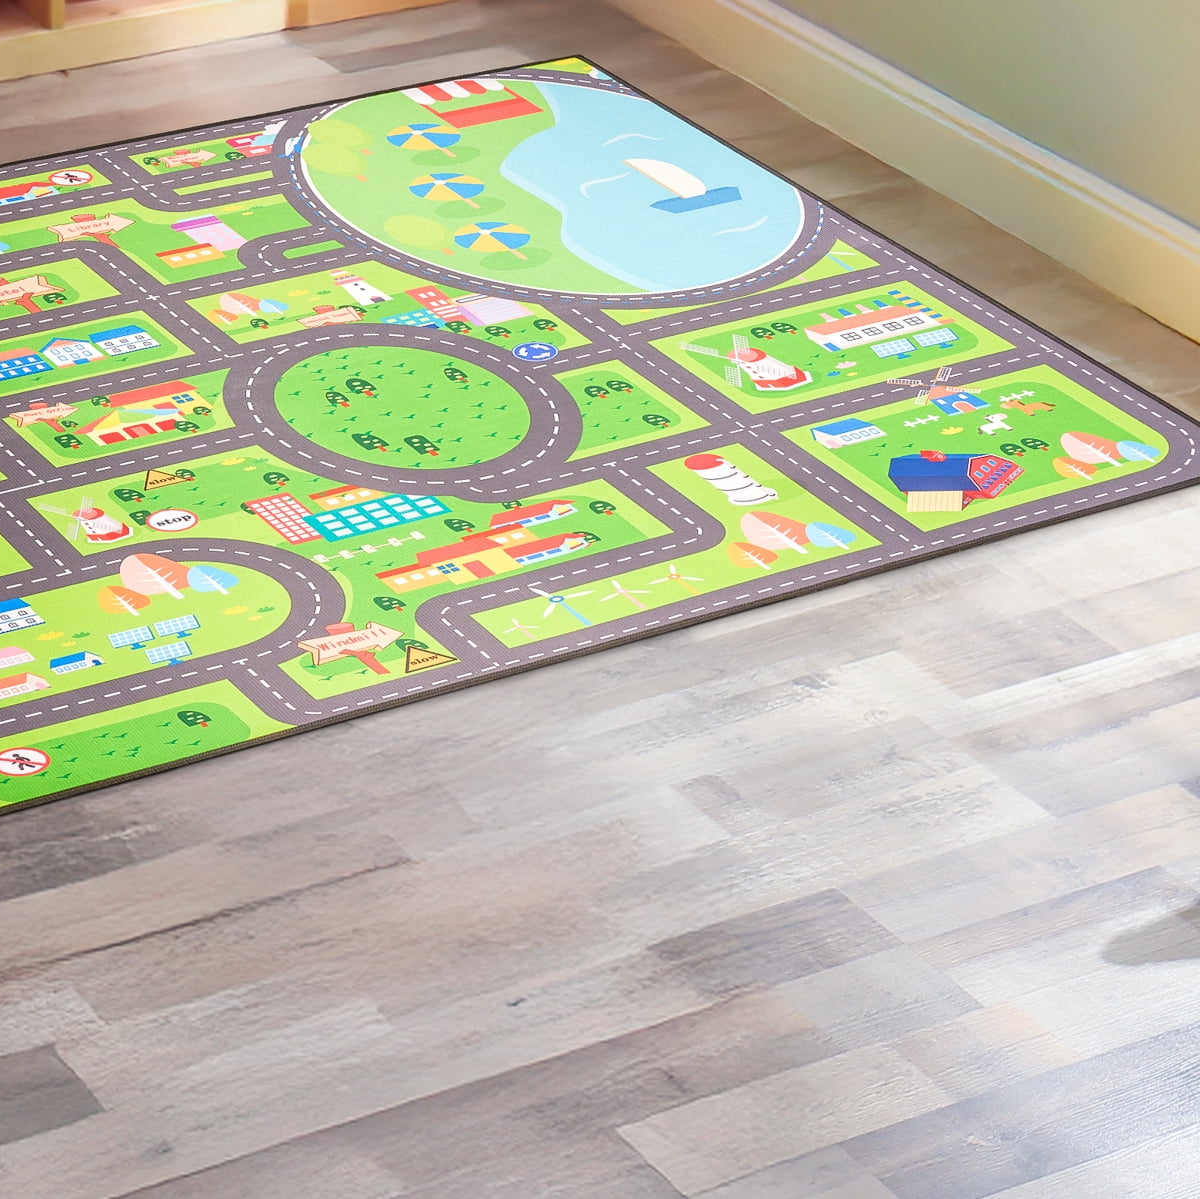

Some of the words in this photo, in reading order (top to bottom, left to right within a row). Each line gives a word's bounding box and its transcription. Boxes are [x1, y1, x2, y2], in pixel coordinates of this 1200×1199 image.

[67, 220, 110, 233] Library
[23, 410, 43, 418] Post
[46, 406, 77, 415] Office
[148, 476, 176, 486] slow
[156, 514, 193, 527] stop
[316, 628, 388, 652] Windmill
[409, 654, 439, 667] slow
